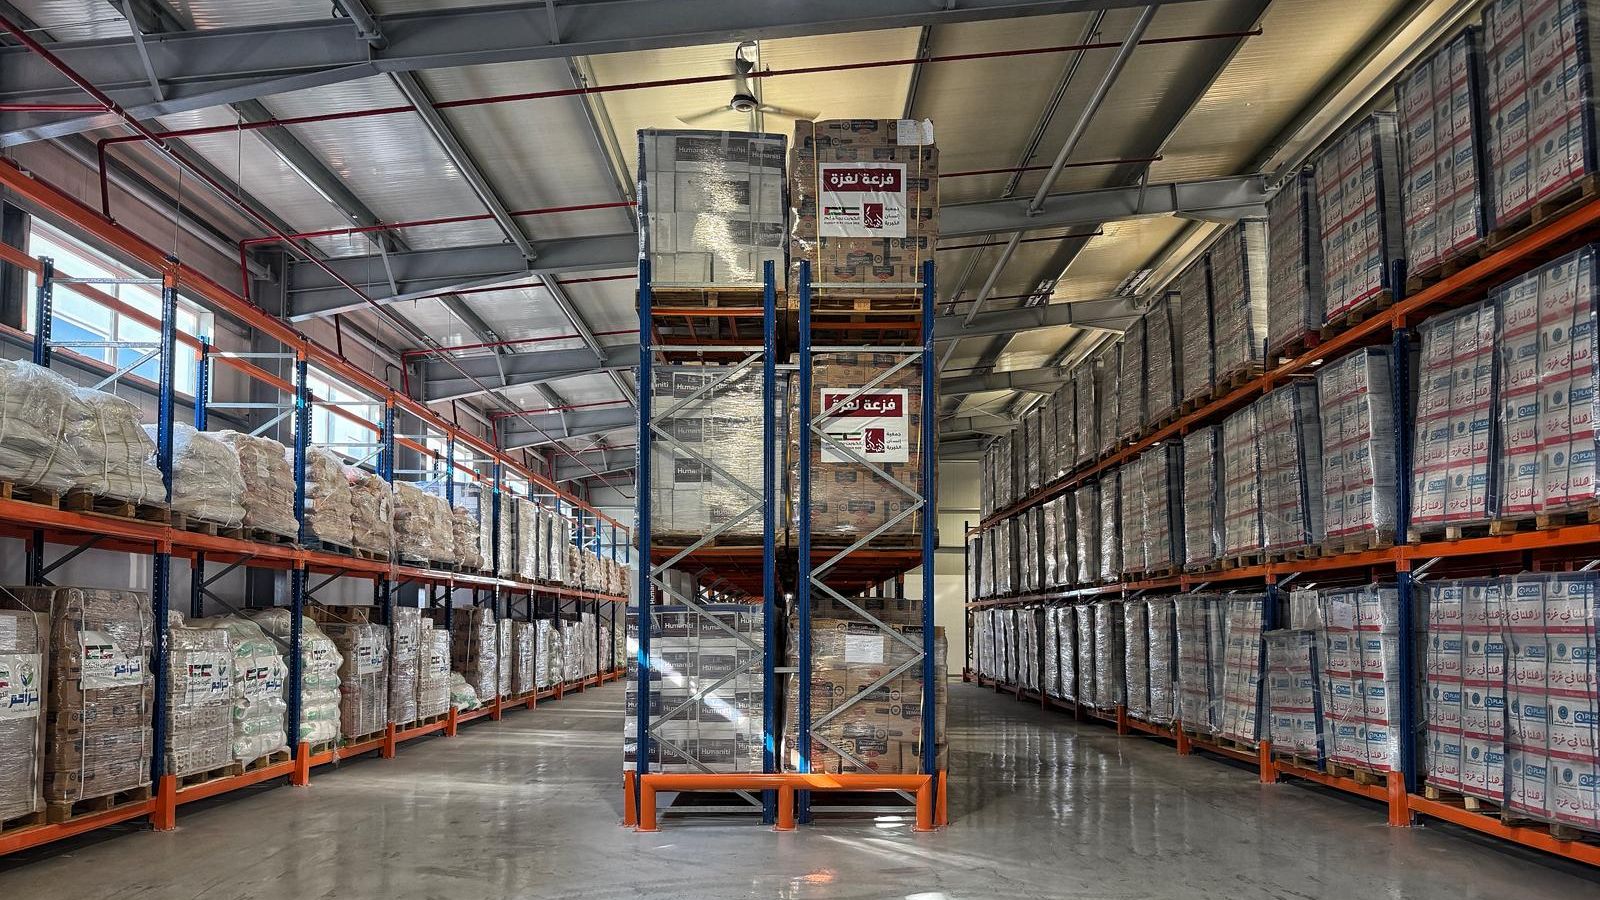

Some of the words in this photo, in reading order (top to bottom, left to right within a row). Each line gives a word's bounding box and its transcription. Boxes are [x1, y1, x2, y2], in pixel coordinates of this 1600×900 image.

[830, 172, 858, 188] لغزة
[862, 172, 894, 188] فزعة
[864, 398, 895, 413] فزعة
